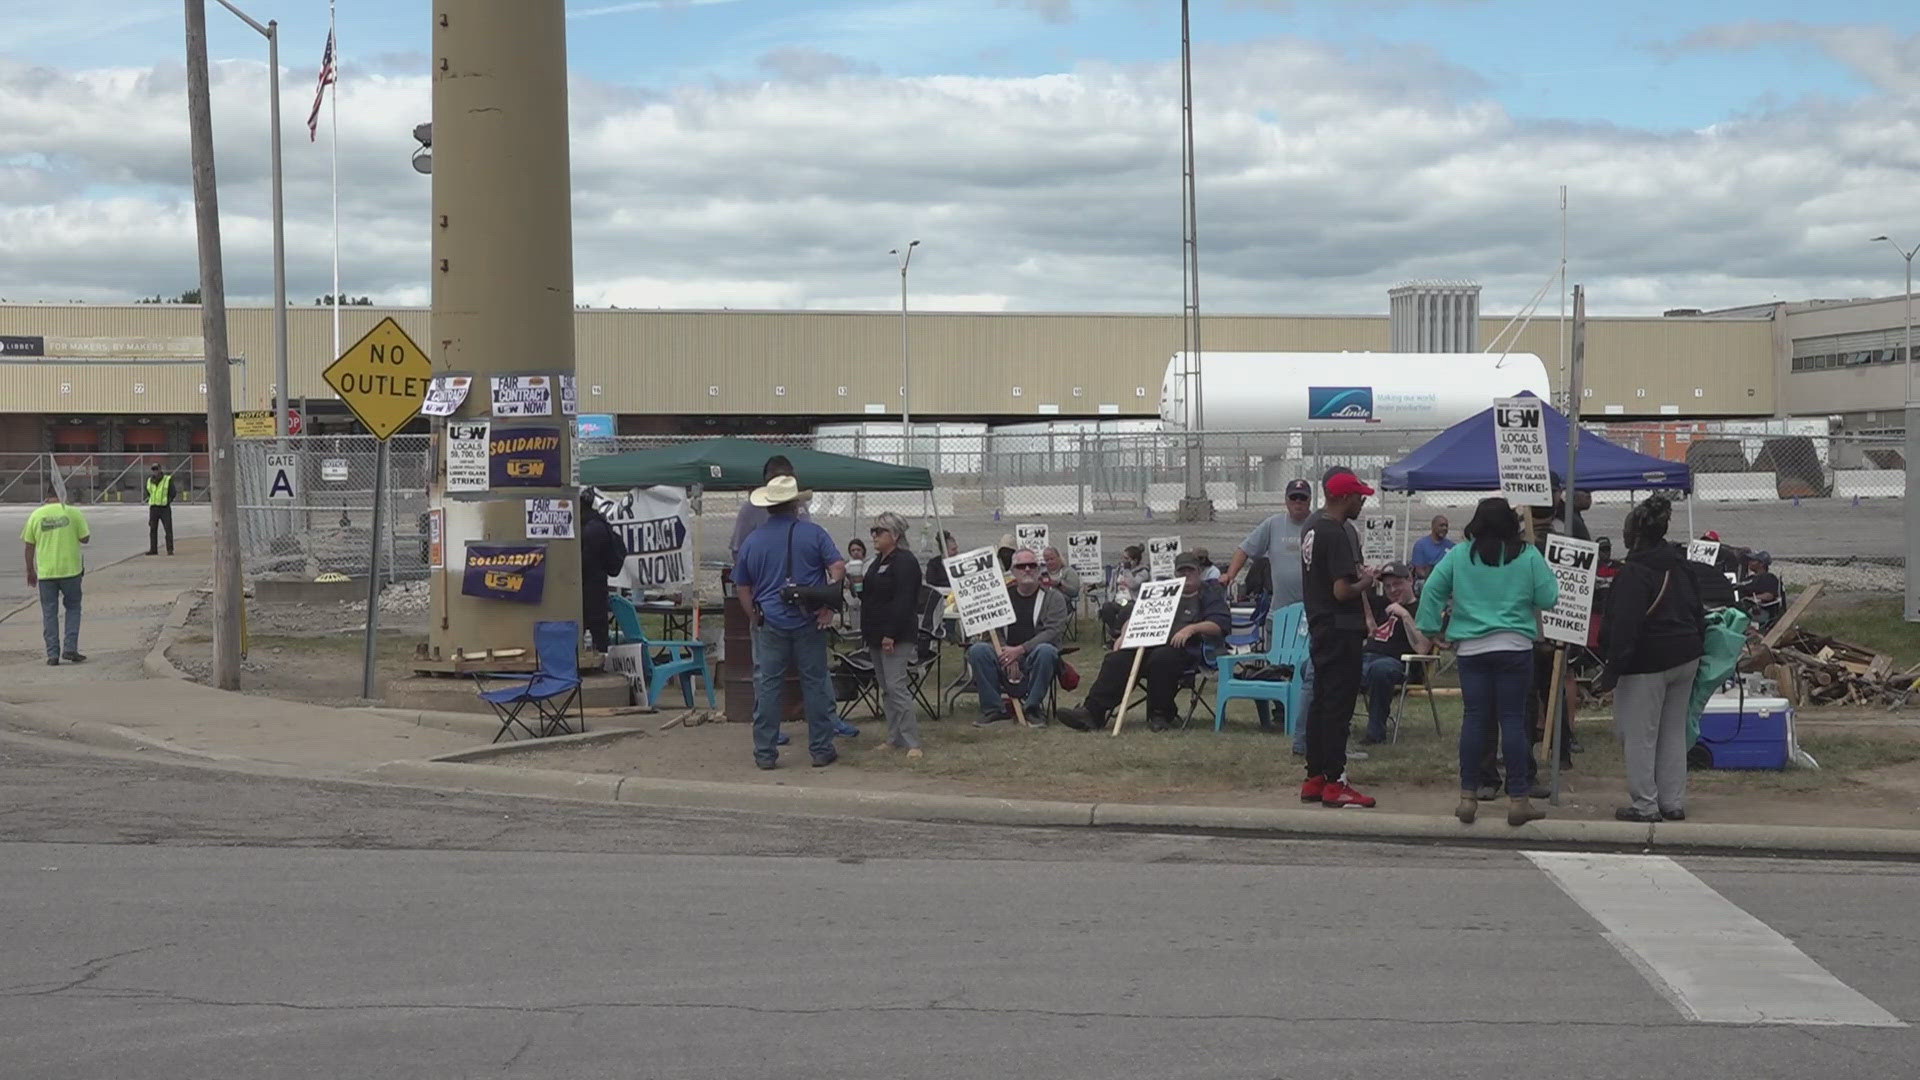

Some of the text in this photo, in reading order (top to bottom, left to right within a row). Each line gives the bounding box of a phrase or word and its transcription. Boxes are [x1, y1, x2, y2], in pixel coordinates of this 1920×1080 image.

[370, 343, 404, 365] NO
[340, 372, 431, 398] OUTLET
[498, 376, 519, 389] FAIR
[499, 388, 546, 402] CONTRACT
[523, 401, 547, 414] NOW!
[1331, 404, 1371, 417] Linde
[240, 411, 270, 419] NOTICE
[1497, 409, 1540, 428] USW
[450, 427, 487, 440] USW
[1502, 432, 1539, 444] LOCALS
[453, 442, 483, 450] LOCALS
[490, 436, 559, 456] SOLIDARITY
[1500, 444, 1543, 455] 59, 700, 65
[268, 456, 295, 467] GATE
[451, 451, 460, 459] 59,
[461, 451, 475, 459] 700,
[506, 460, 545, 477] USW
[269, 469, 295, 498] A
[1525, 473, 1547, 481] GLASS
[532, 498, 551, 511] FAIR
[532, 511, 570, 524] CONTRACT
[612, 518, 678, 553] NTRACT
[1018, 529, 1046, 538] USW
[1069, 536, 1098, 546] USW
[1150, 541, 1179, 553] USW
[469, 552, 544, 567] SOLIDARITY
[1548, 544, 1595, 570] USW
[638, 551, 685, 585] NOW!
[949, 554, 994, 578] USW
[484, 571, 524, 592] USW
[959, 572, 996, 589] LOCALS
[1555, 569, 1587, 584] OCALS
[958, 579, 1001, 598] 59, 700, 65
[1141, 584, 1181, 600] USW
[1560, 581, 1589, 596] 700, 65
[986, 600, 1008, 610] GLASS
[1140, 600, 1173, 609] LOCALS
[1561, 601, 1588, 612] PRACTICE
[1565, 610, 1588, 621] GLASS
[612, 655, 637, 674] UNION
